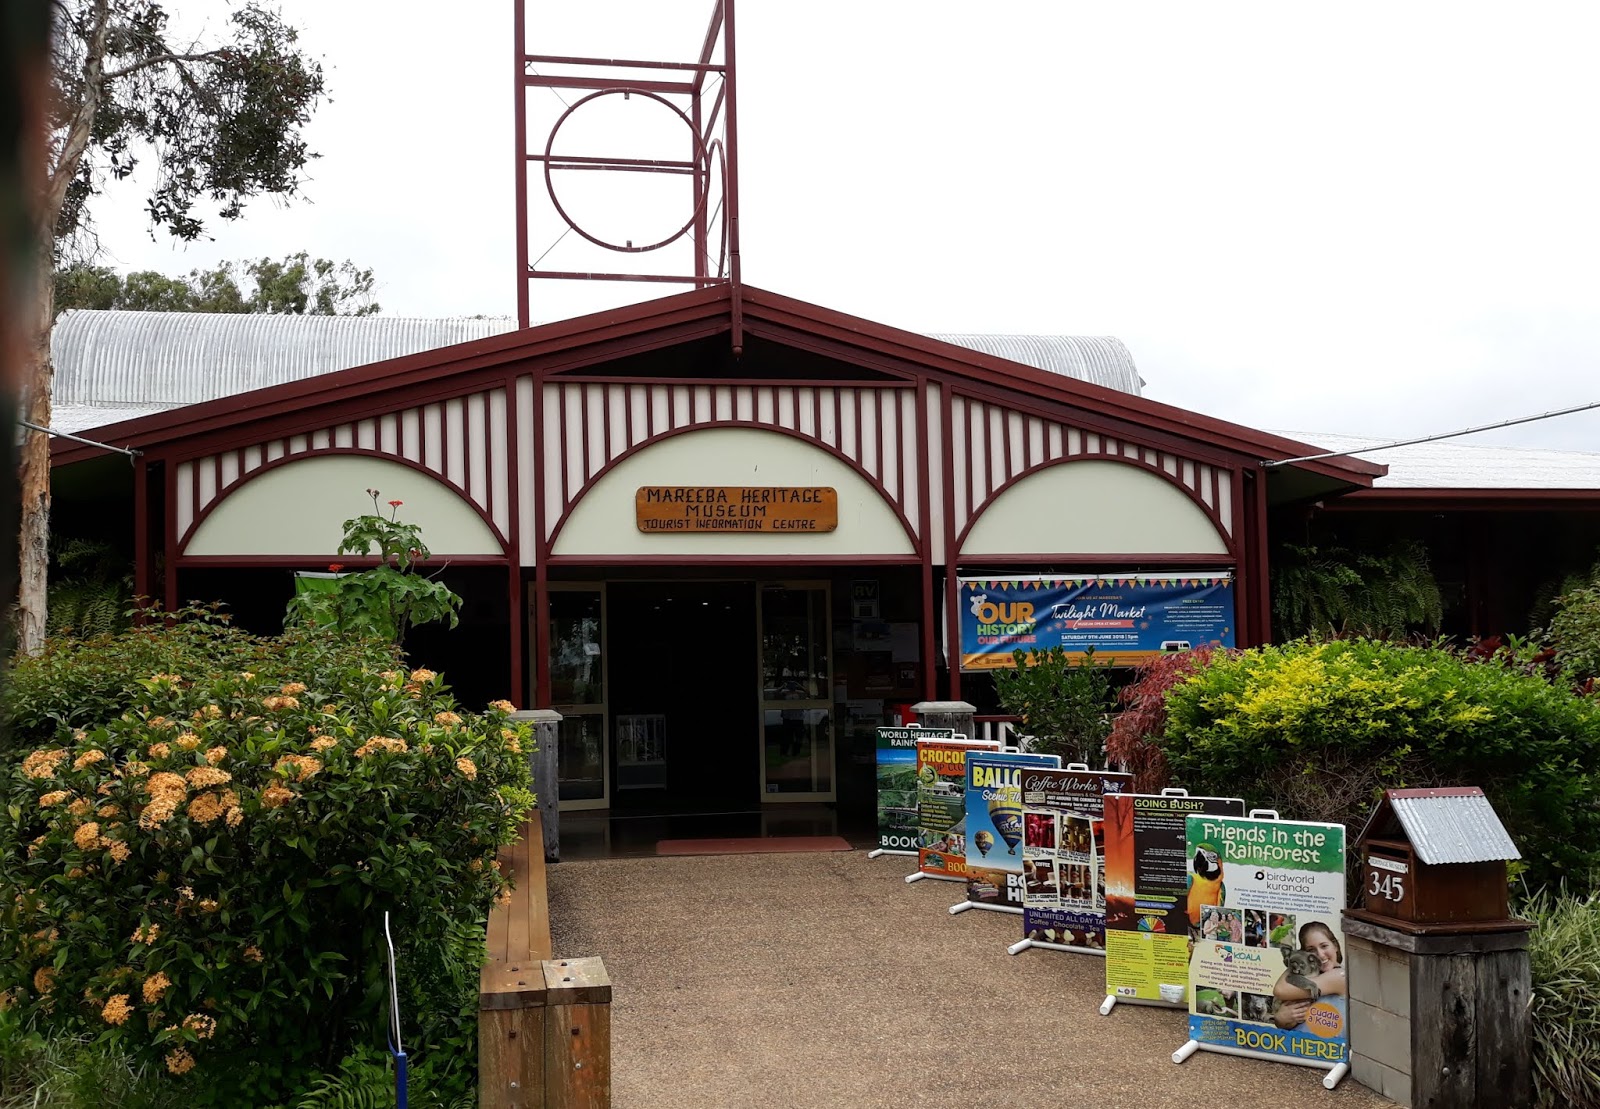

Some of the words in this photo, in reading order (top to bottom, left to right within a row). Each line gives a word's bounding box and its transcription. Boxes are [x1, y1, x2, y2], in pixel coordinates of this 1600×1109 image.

[647, 488, 727, 503] MAREEBA
[741, 487, 822, 503] HERITAGE
[685, 505, 766, 517] MUSEUM
[644, 519, 690, 529] TOURIST
[696, 518, 762, 529] INFORMATION
[773, 519, 816, 529] CENTRE
[855, 585, 875, 596] RV
[978, 602, 1036, 624] OUR
[1051, 603, 1097, 630] Twilight
[1099, 602, 1146, 618] Market
[976, 623, 1036, 636] HISTORY
[977, 636, 999, 645] OUR
[1000, 635, 1036, 644] FUTURE
[1025, 775, 1058, 792] Coffee
[1059, 777, 1098, 791] Works
[982, 790, 1008, 802] Scenic
[1134, 799, 1167, 808] GOING
[1170, 800, 1204, 810] BUSH?
[1202, 823, 1266, 843] Friends
[1272, 827, 1288, 844] in
[1292, 830, 1325, 847] the
[882, 836, 918, 848] BOOK
[1222, 840, 1320, 863] Rainforest
[1267, 872, 1314, 884] birdworld
[1267, 882, 1310, 893] kuranda
[1369, 871, 1404, 902] 345
[1029, 911, 1064, 920] UNLIMITED
[1053, 920, 1084, 930] Chocolate
[1234, 952, 1261, 961] KOALA
[1310, 1007, 1340, 1021] Cuddle
[1315, 1017, 1338, 1029] Koala
[1235, 1028, 1287, 1053] BOOK
[1292, 1038, 1344, 1059] HERE!
